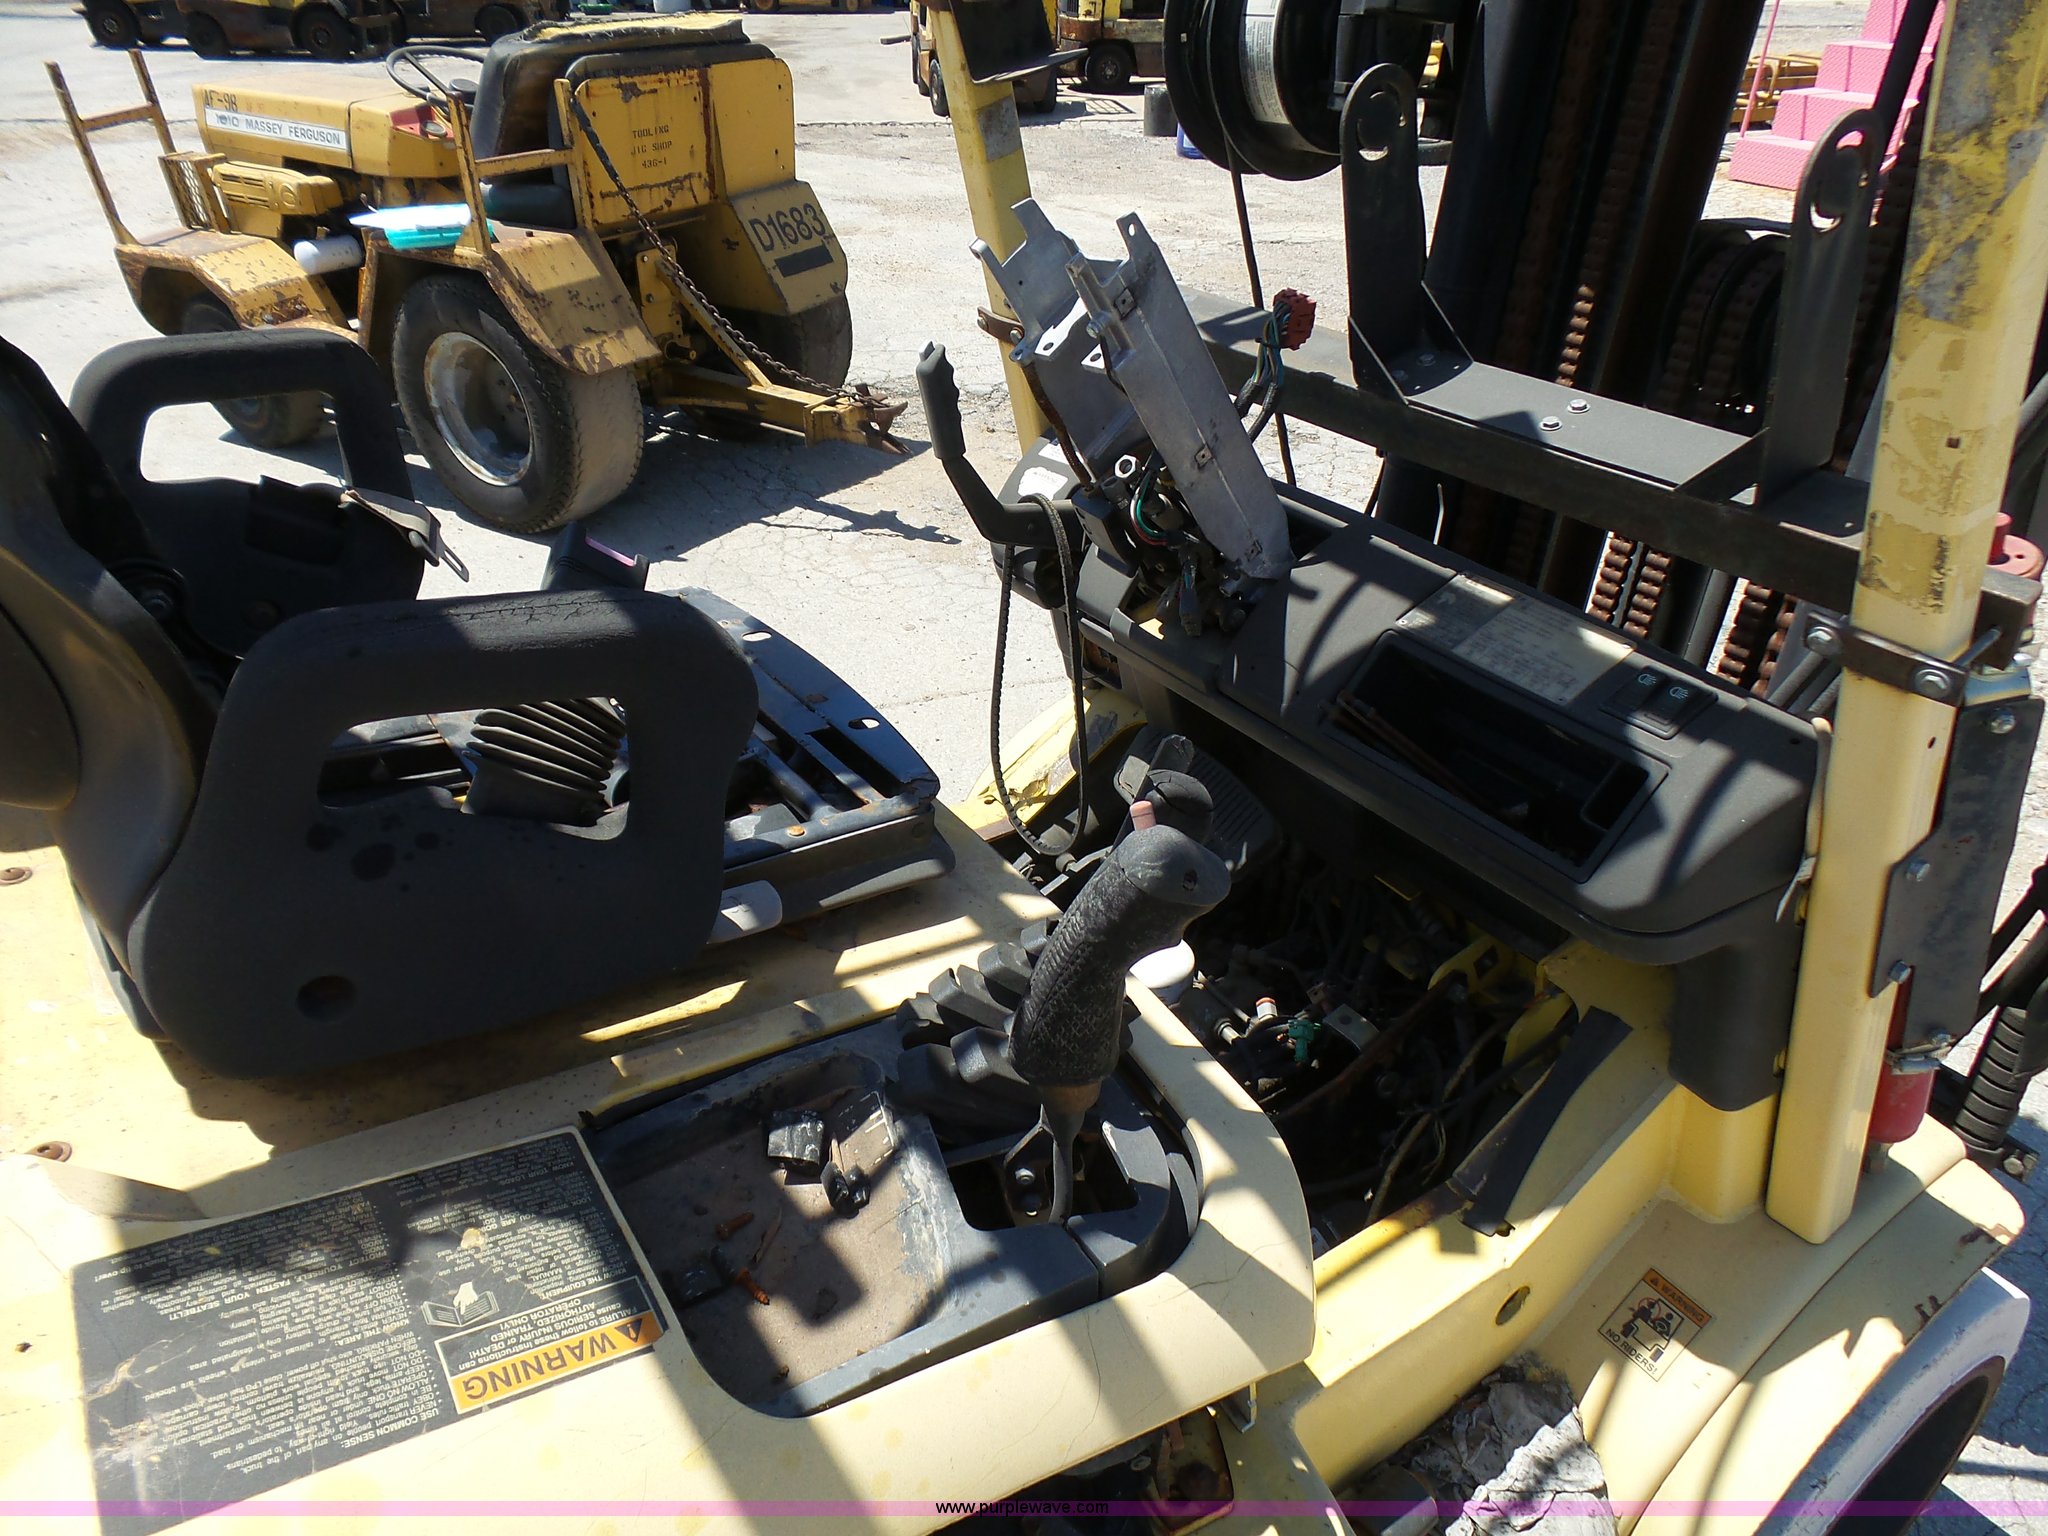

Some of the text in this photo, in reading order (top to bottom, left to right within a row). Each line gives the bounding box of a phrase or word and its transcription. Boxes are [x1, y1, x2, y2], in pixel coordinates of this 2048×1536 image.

[245, 118, 282, 135] MASSEY
[288, 126, 341, 145] FERGUSON
[652, 140, 672, 151] SHOP
[748, 203, 826, 252] D1683
[500, 1217, 516, 1226] ARE
[348, 1250, 386, 1266] PROTECT
[560, 1252, 584, 1264] operate
[453, 1261, 474, 1271] before
[492, 1265, 503, 1273] not
[586, 1267, 626, 1284] KNOW THE
[221, 1288, 235, 1297] and
[255, 1278, 290, 1294] FASTEN
[368, 1285, 383, 1294] NOT
[375, 1287, 398, 1298] AVOID
[223, 1290, 249, 1304] YOUR
[168, 1299, 219, 1320] SEATBELT!
[363, 1300, 378, 1309] OFF
[595, 1301, 622, 1316] cause
[1662, 1286, 1705, 1323] WARNING
[498, 1297, 581, 1330] OPERATOR ONLY!
[552, 1310, 595, 1330] SERIOUS
[598, 1306, 637, 1323] FAILURE
[489, 1300, 596, 1342] AUTHORIZED, TRAINED
[334, 1318, 409, 1347] KNOW THE AREA:
[518, 1324, 553, 1342] INJURY
[559, 1322, 588, 1336] follow
[533, 1332, 559, 1345] these
[180, 1311, 407, 1389] NEVER car are
[210, 1344, 252, 1363] designated
[468, 1340, 505, 1358] DEATH!
[1605, 1328, 1658, 1375] NO RIDERS!
[245, 1330, 413, 1390] WHEN LPG
[390, 1354, 407, 1364] NOT
[392, 1361, 409, 1371] NOT
[458, 1359, 476, 1370] can
[461, 1330, 616, 1401] WARNING
[351, 1367, 369, 1377] truck
[368, 1368, 388, 1379] move
[281, 1383, 299, 1393] work
[296, 1381, 322, 1396] people
[346, 1376, 365, 1387] truck
[401, 1377, 429, 1392] ALLOW
[305, 1385, 334, 1401] anyone
[331, 1370, 427, 1408] OPERATE truck only from
[195, 1363, 425, 1446] KEEP and head inside operator's compartment.
[267, 1393, 292, 1406] unless
[366, 1392, 385, 1404] ONE
[373, 1391, 407, 1409] complete
[412, 1392, 434, 1404] OBEY
[230, 1407, 251, 1418] other
[260, 1400, 293, 1416] between
[342, 1400, 363, 1412] under
[345, 1405, 371, 1419] control
[388, 1401, 409, 1413] traffic
[409, 1400, 436, 1414] NEVER
[237, 1413, 256, 1424] truck
[307, 1413, 325, 1425] near
[366, 1409, 386, 1420] rules.
[374, 1408, 408, 1427] transport
[216, 1421, 232, 1431] and
[321, 1419, 330, 1428] all
[339, 1419, 358, 1430] Yield
[340, 1407, 438, 1448] USE COMMON SENSE:
[345, 1421, 371, 1437] people
[247, 1425, 292, 1445] mechanism
[313, 1436, 328, 1448] any
[209, 1446, 231, 1459] load.
[295, 1441, 313, 1455] part
[223, 1447, 272, 1471] pedestrians.
[266, 1455, 279, 1465] the
[239, 1461, 262, 1475] truck.
